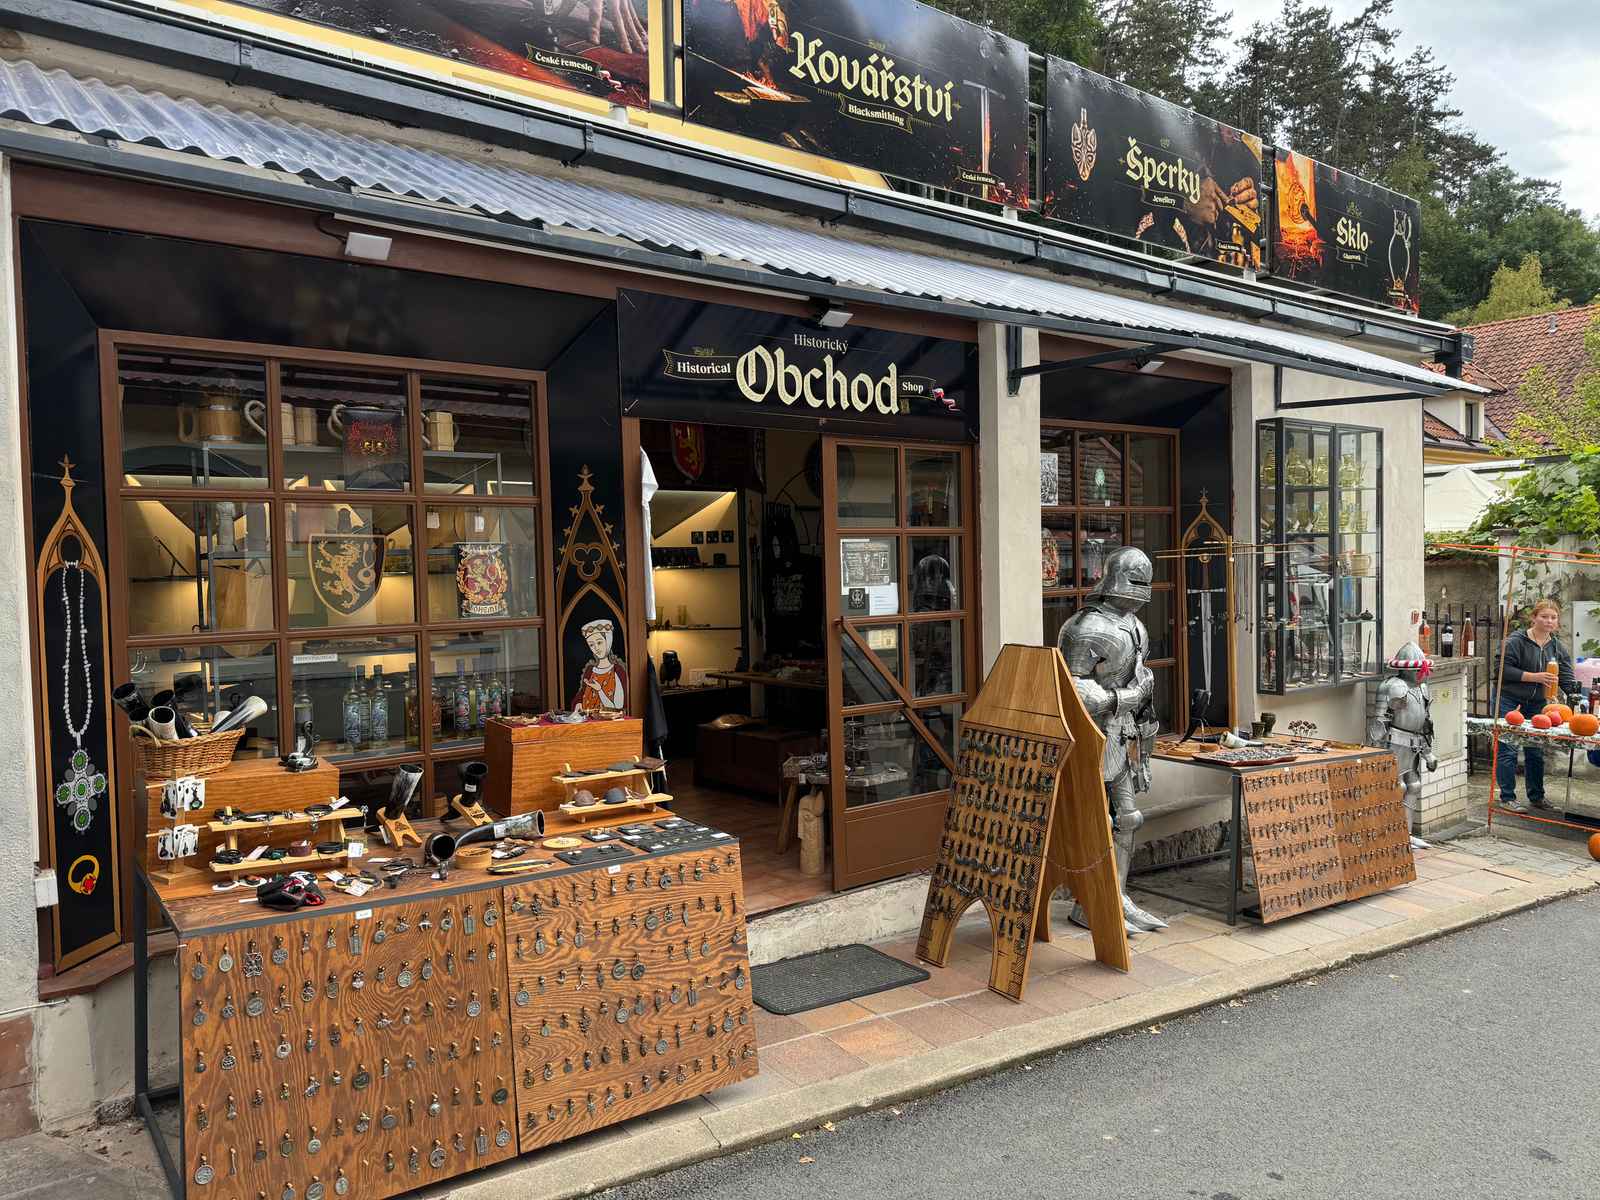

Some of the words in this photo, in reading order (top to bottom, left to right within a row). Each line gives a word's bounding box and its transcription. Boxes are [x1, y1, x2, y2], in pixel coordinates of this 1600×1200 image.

[788, 31, 954, 122] Kovářství
[848, 104, 905, 126] Blacksmithing
[1126, 136, 1200, 204] Šperky
[1336, 217, 1368, 251] Sklo
[794, 333, 849, 354] Historický
[677, 361, 731, 374] Historical
[736, 344, 899, 415] Obchod
[902, 381, 924, 394] Shop
